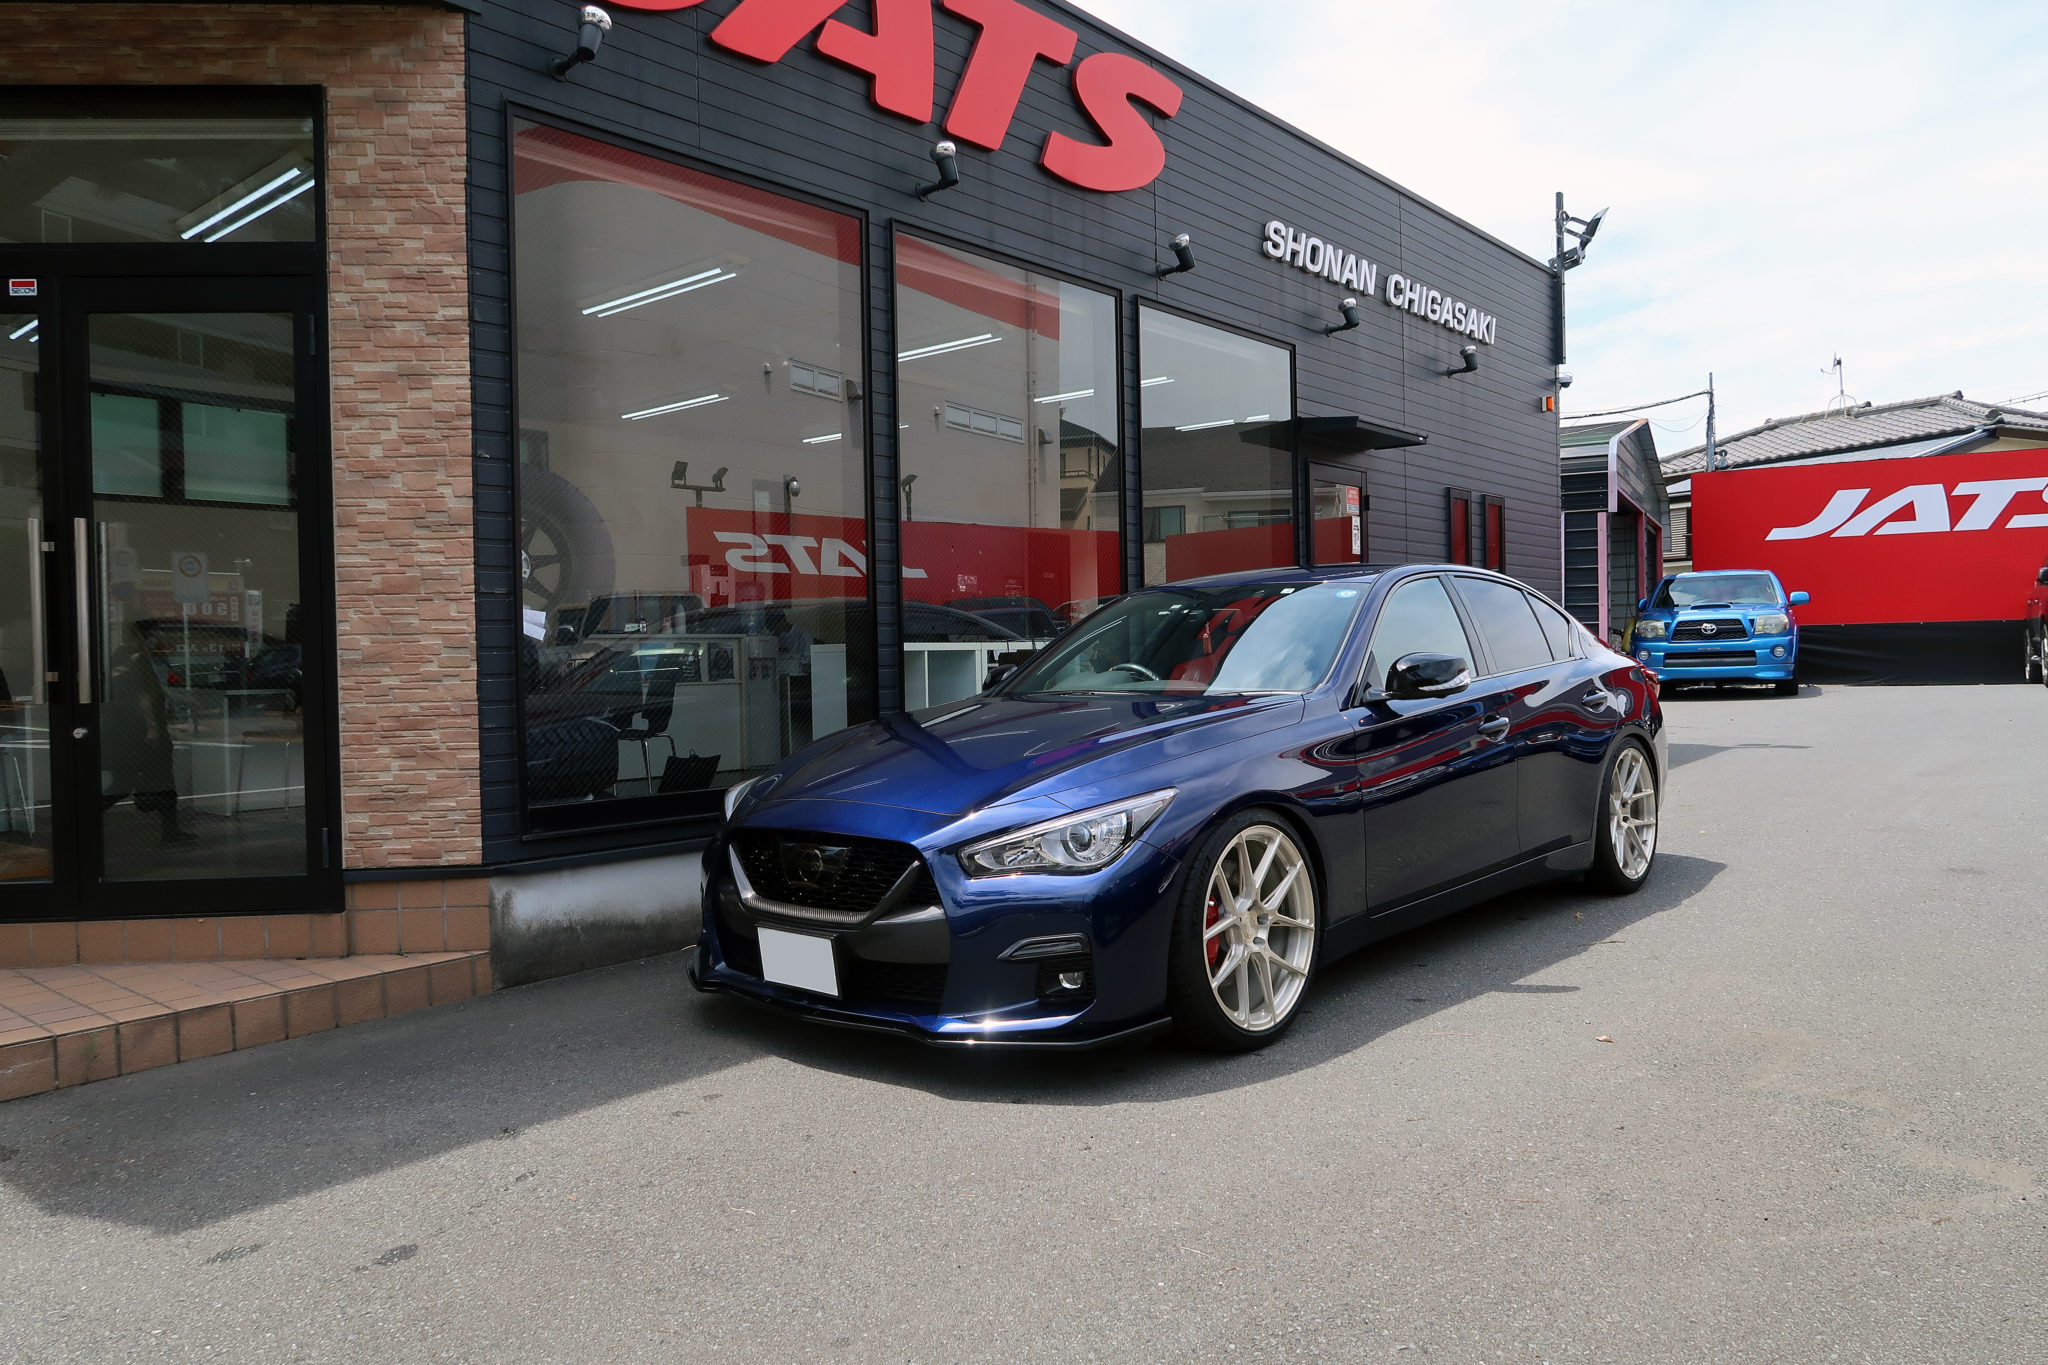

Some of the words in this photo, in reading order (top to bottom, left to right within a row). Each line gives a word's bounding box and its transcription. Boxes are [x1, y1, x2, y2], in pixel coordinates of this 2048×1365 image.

[600, 0, 1184, 193] ATS
[1263, 220, 1377, 296] SHONAN
[1386, 273, 1497, 345] CHIGASAKI
[1764, 476, 2048, 541] JAT
